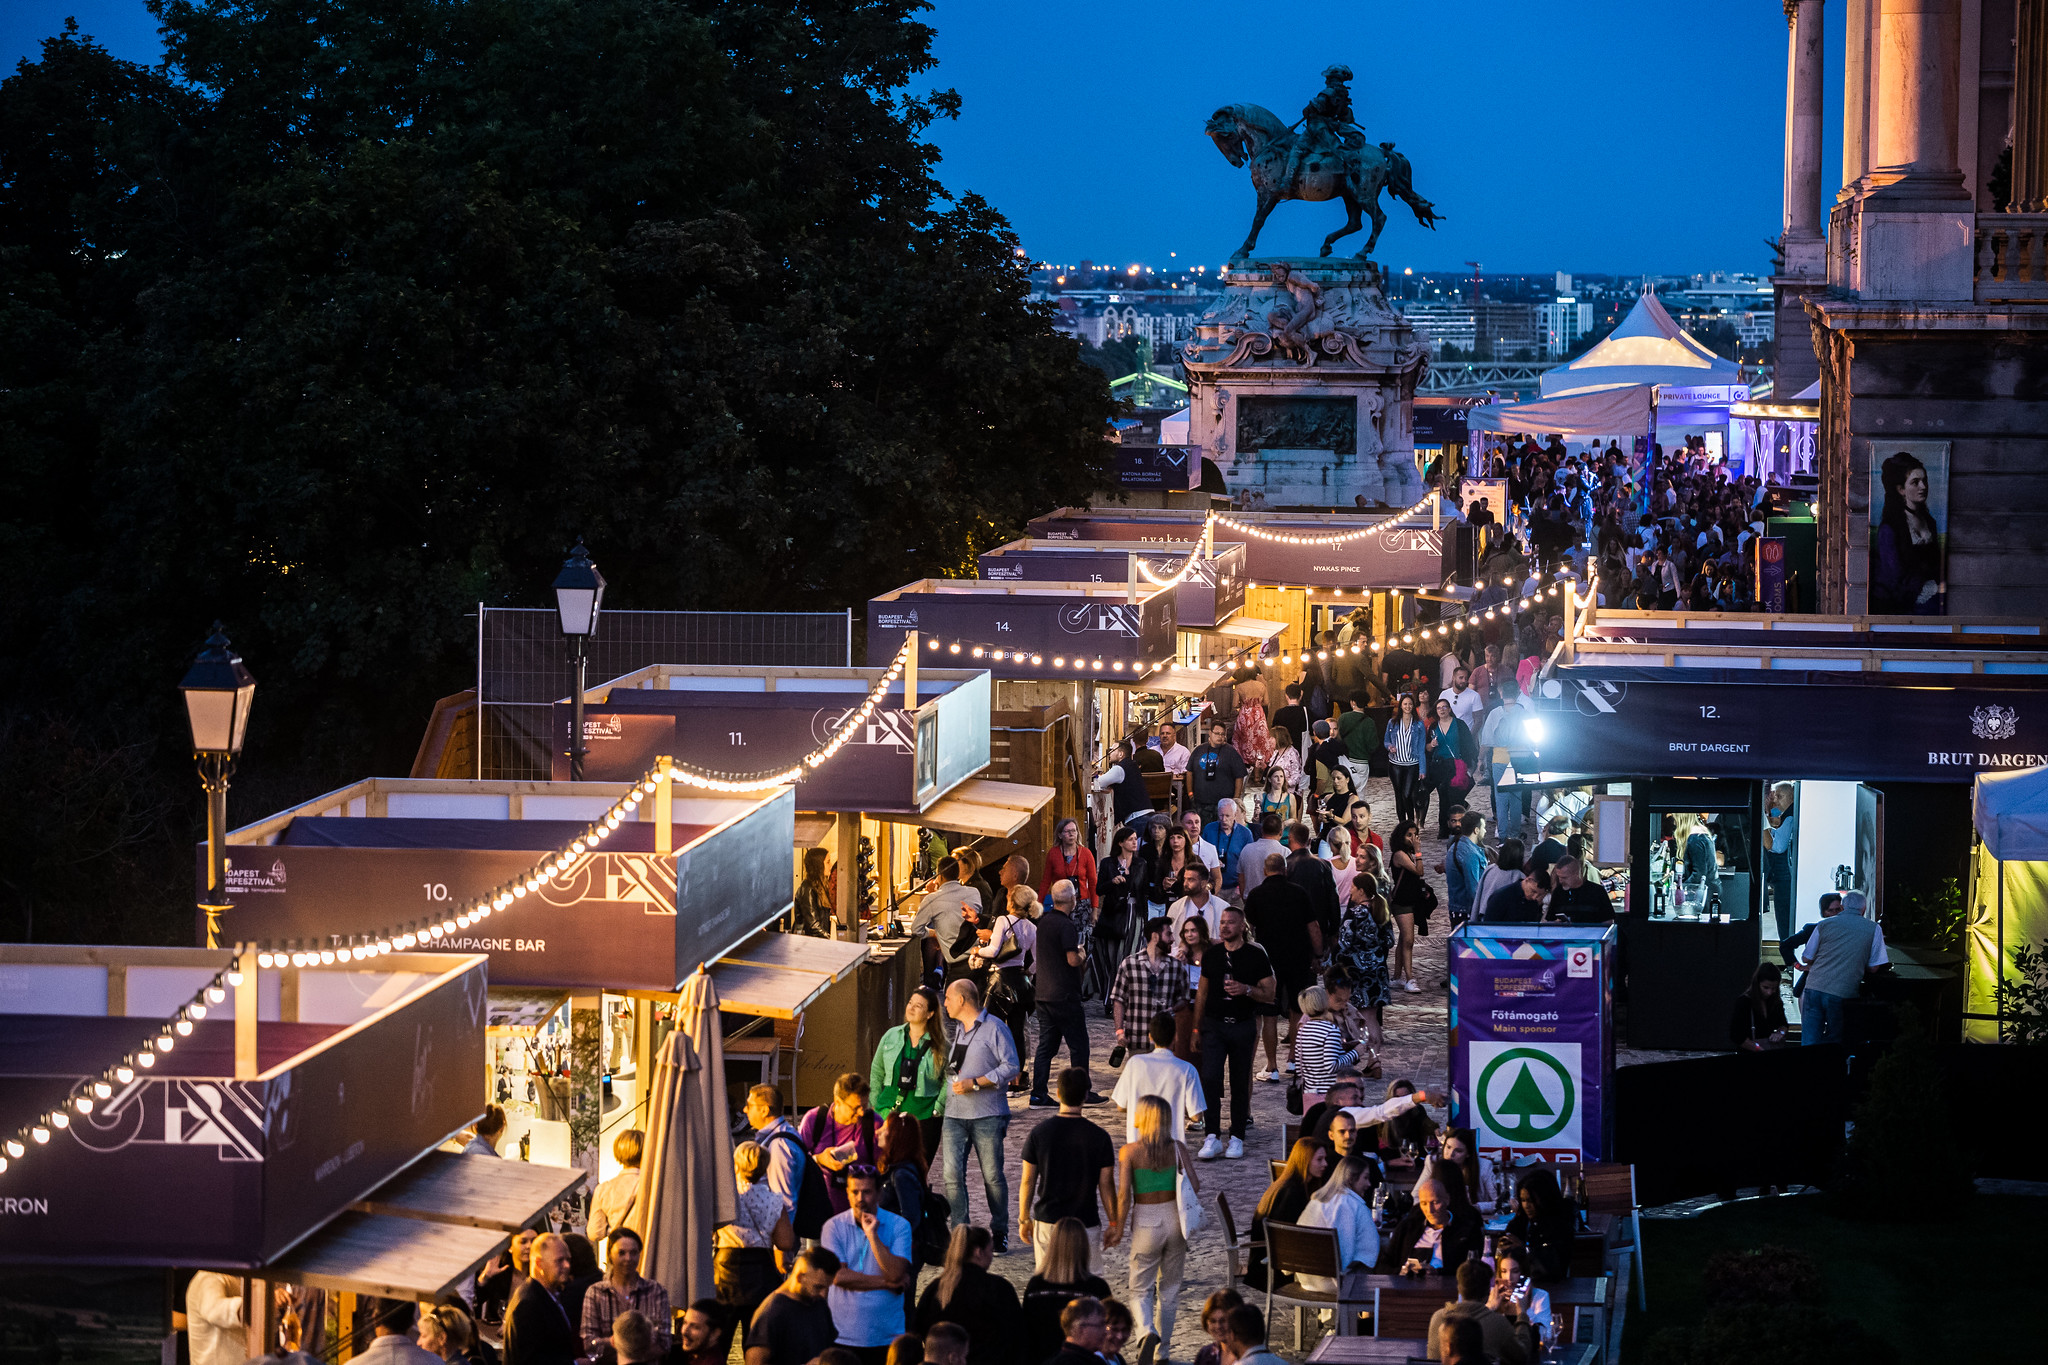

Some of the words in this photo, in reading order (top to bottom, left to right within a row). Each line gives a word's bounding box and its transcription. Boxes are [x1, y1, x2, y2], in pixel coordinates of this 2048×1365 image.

[1332, 543, 1343, 551] 17.
[1090, 574, 1105, 583] 15.
[995, 621, 1012, 632] 14.
[1699, 705, 1720, 718] 12.
[728, 731, 747, 746] 11.
[1669, 743, 1697, 751] BRUT
[1700, 743, 1750, 753] DARGENT
[1928, 752, 1974, 765] BRUT
[423, 883, 453, 901] 10.
[515, 938, 546, 952] BAR
[1491, 1009, 1559, 1022] Főtámogató
[1493, 1023, 1517, 1033] Main
[1520, 1025, 1557, 1034] sponsor
